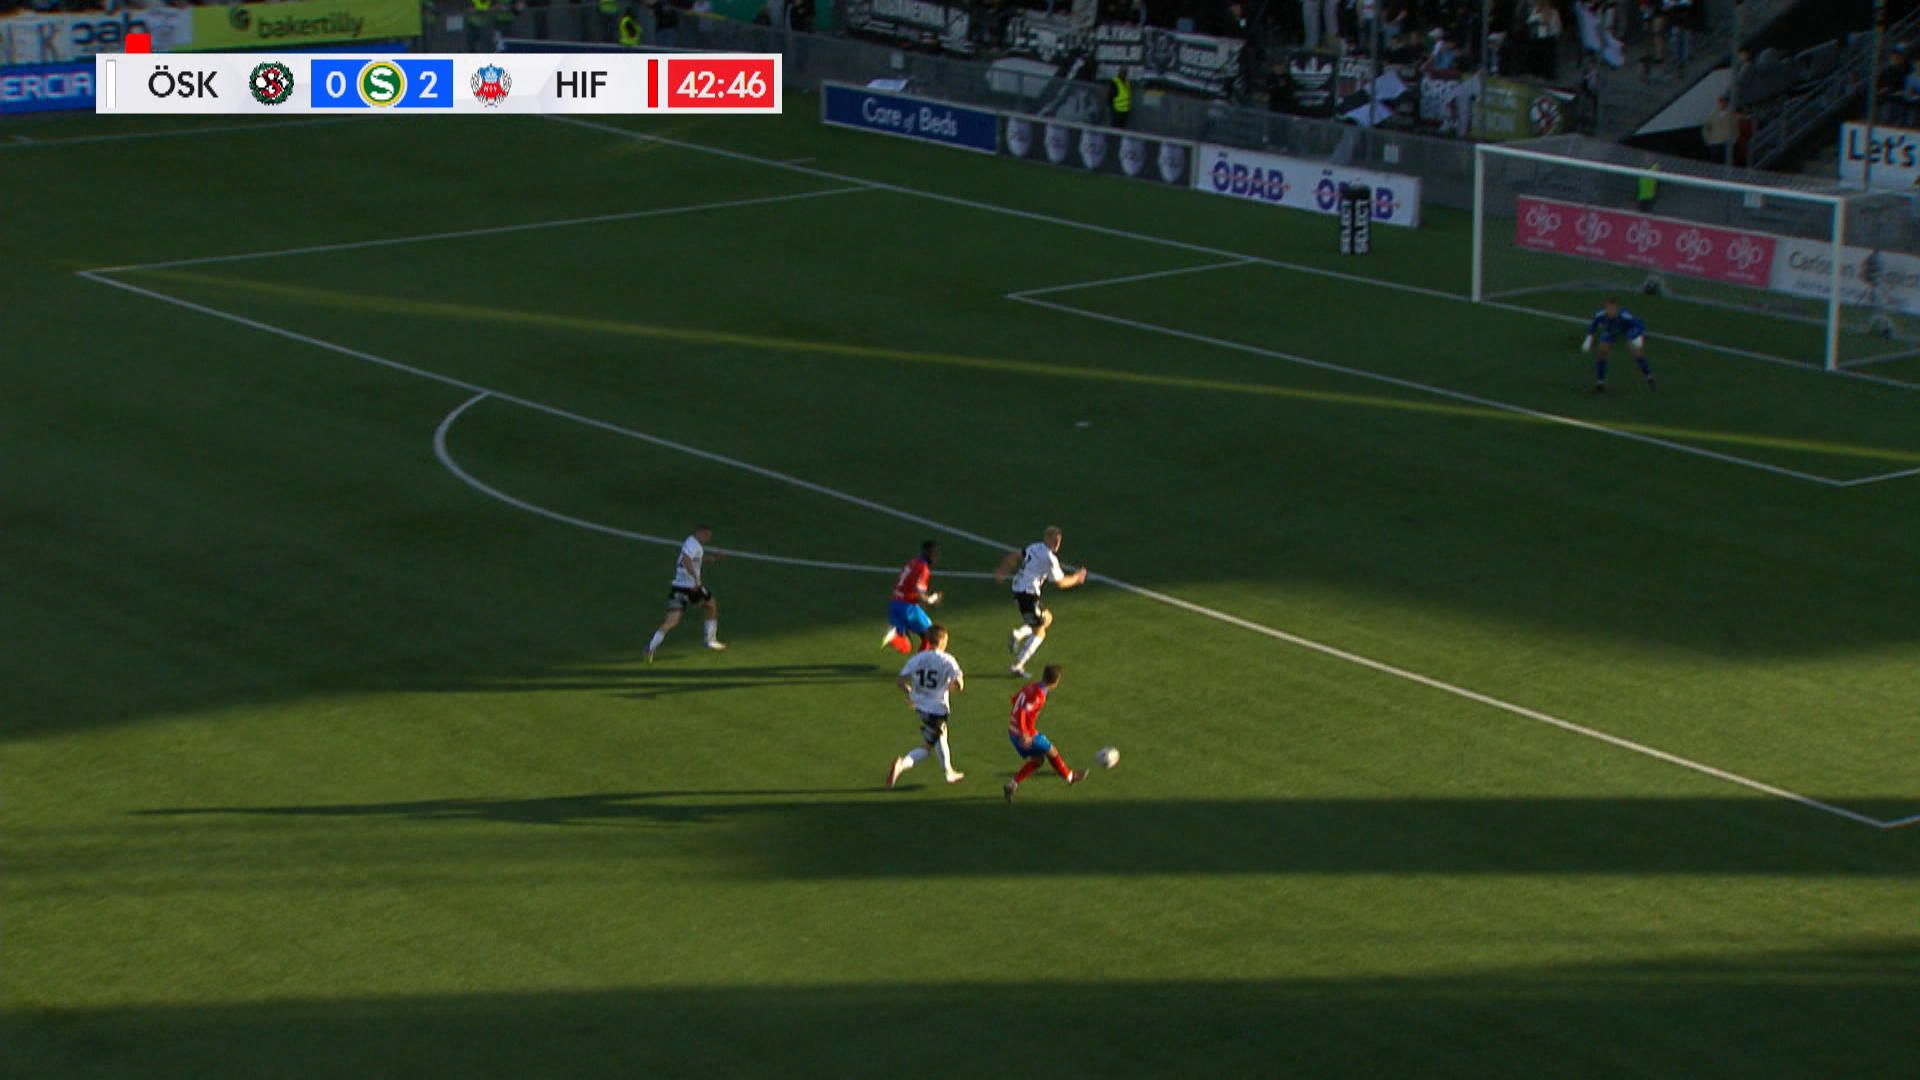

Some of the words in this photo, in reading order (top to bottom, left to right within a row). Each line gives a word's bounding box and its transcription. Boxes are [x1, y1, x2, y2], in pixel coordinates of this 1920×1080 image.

[861, 96, 904, 126] Care
[918, 107, 958, 138] Beds
[1847, 129, 1916, 167] Let's
[1212, 151, 1285, 201] ÖBAB
[1316, 169, 1394, 220] ÖB
[916, 668, 939, 689] 15
